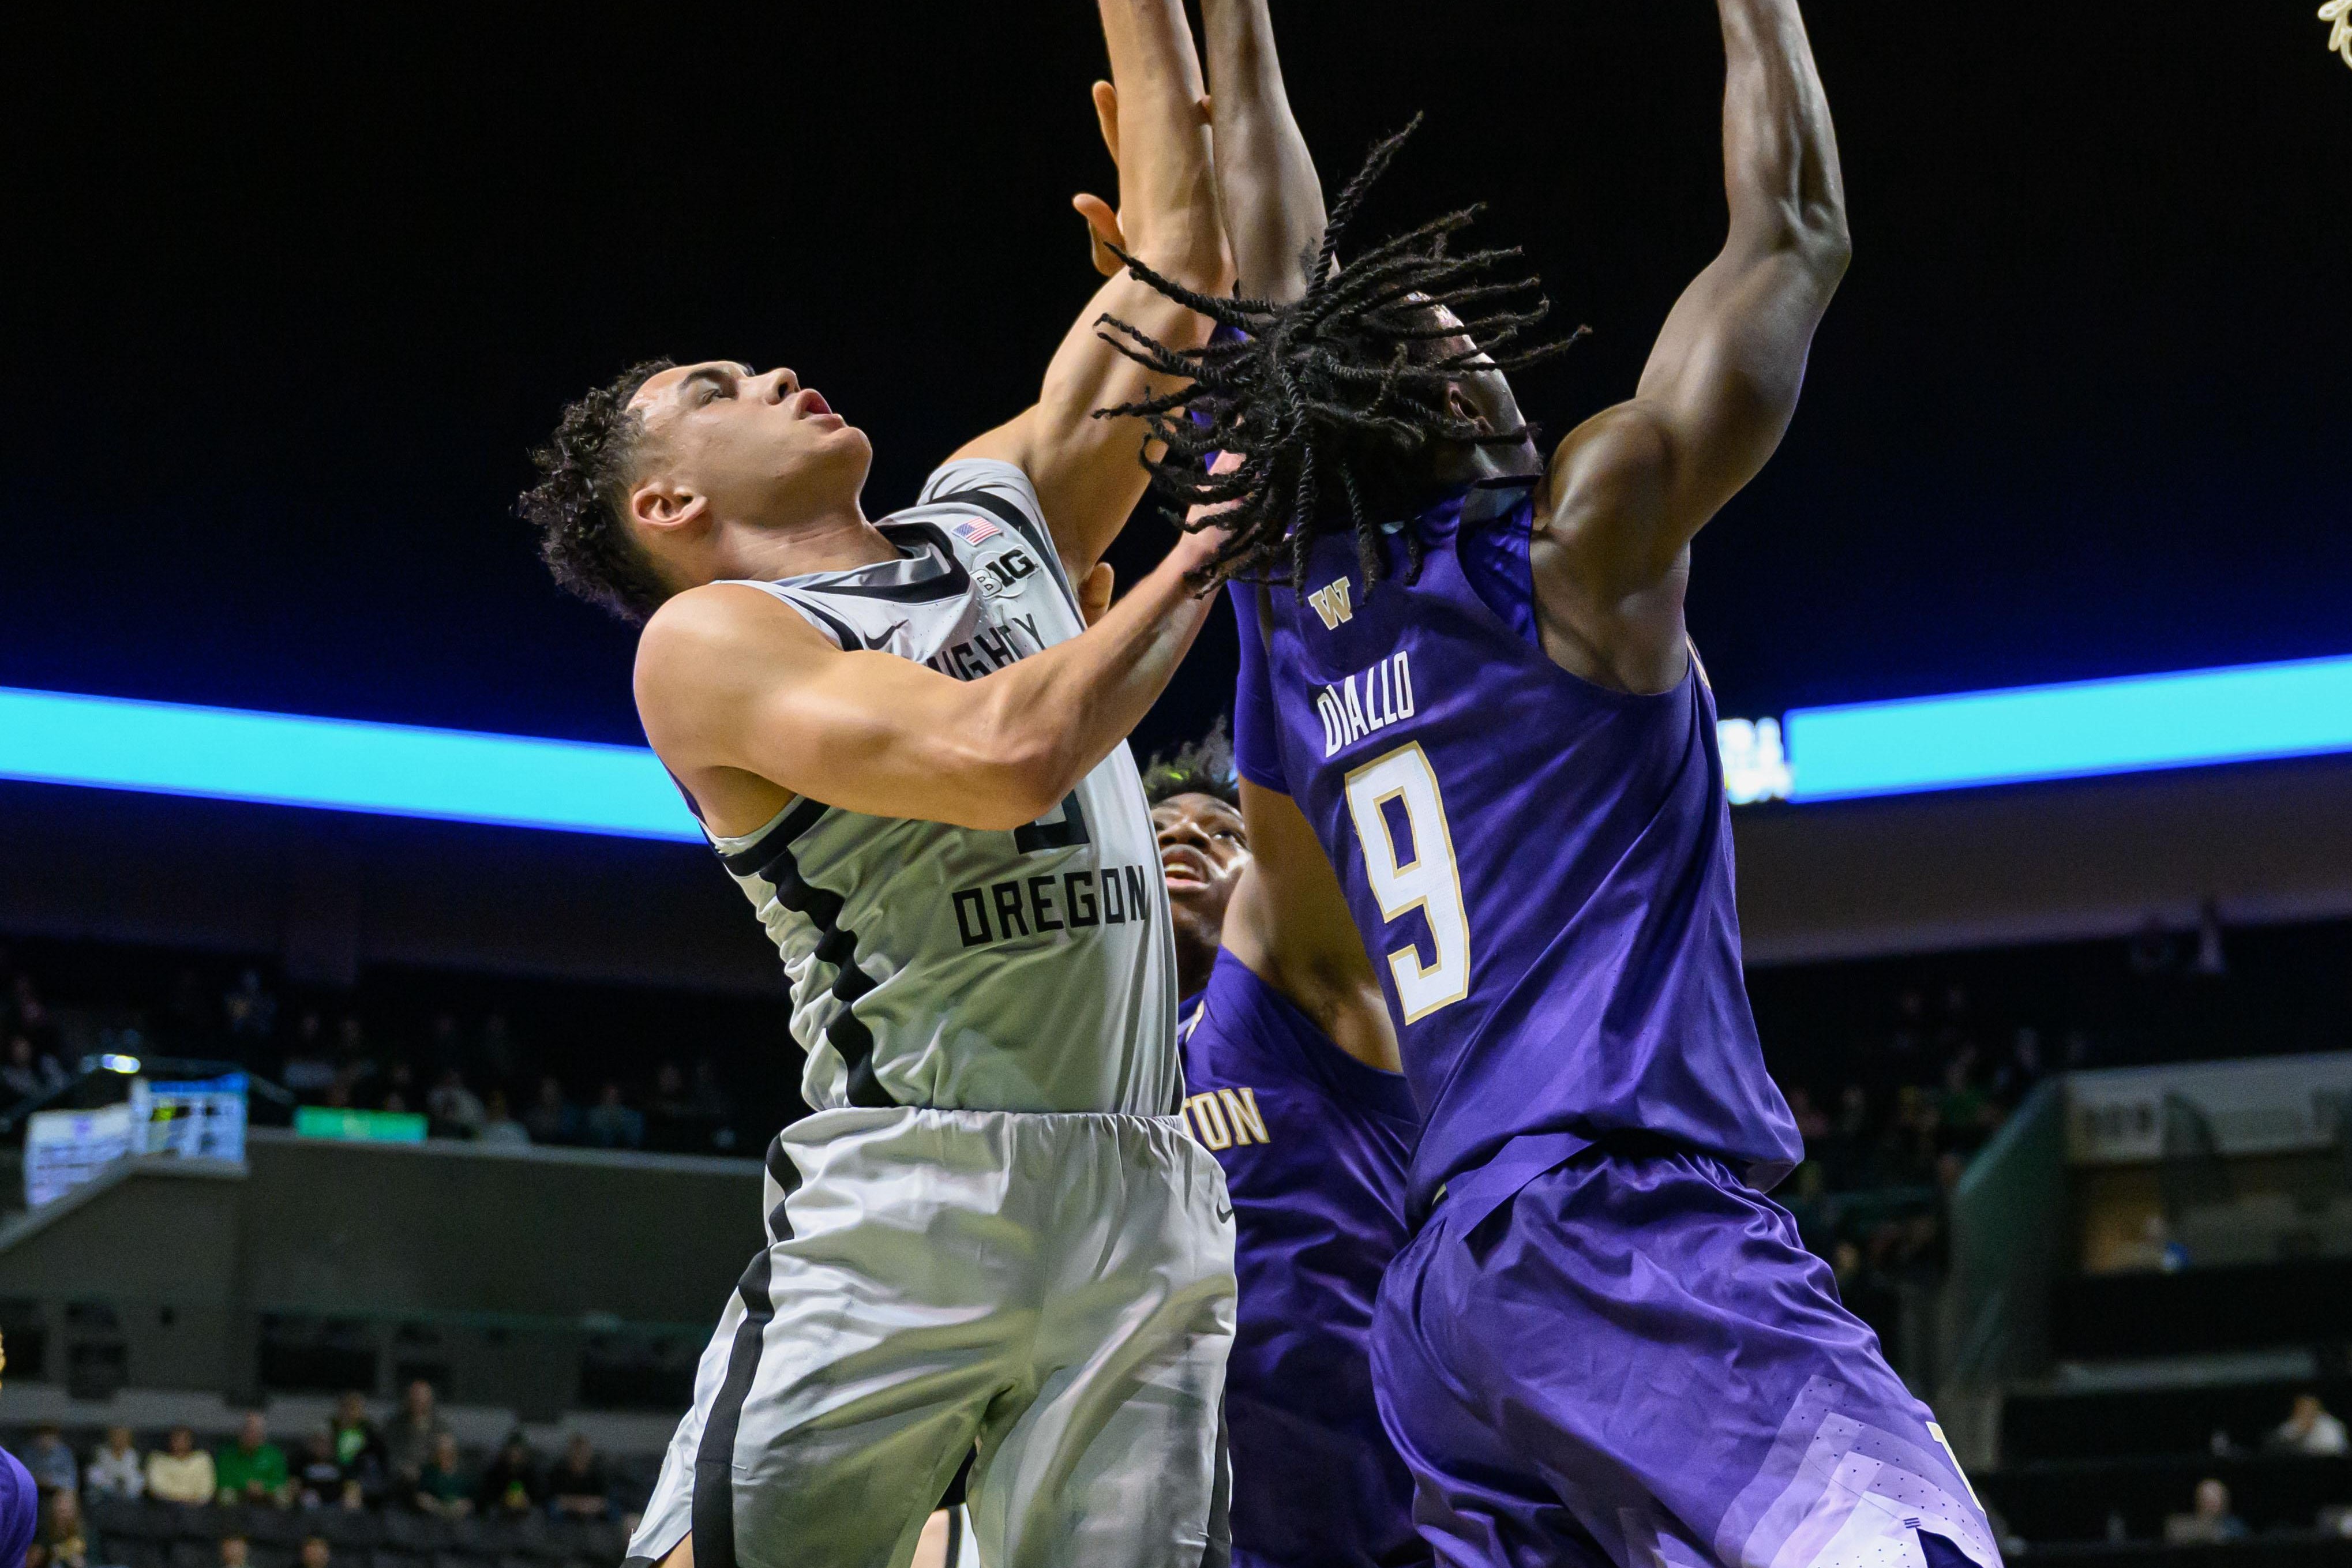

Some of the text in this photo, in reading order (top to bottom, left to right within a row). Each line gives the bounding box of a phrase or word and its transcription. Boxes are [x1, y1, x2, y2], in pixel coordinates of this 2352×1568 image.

[1308, 576, 1353, 630] W
[1316, 651, 1415, 758] DIALLO
[952, 865, 1146, 947] OREGON
[1345, 740, 1470, 1025] 9
